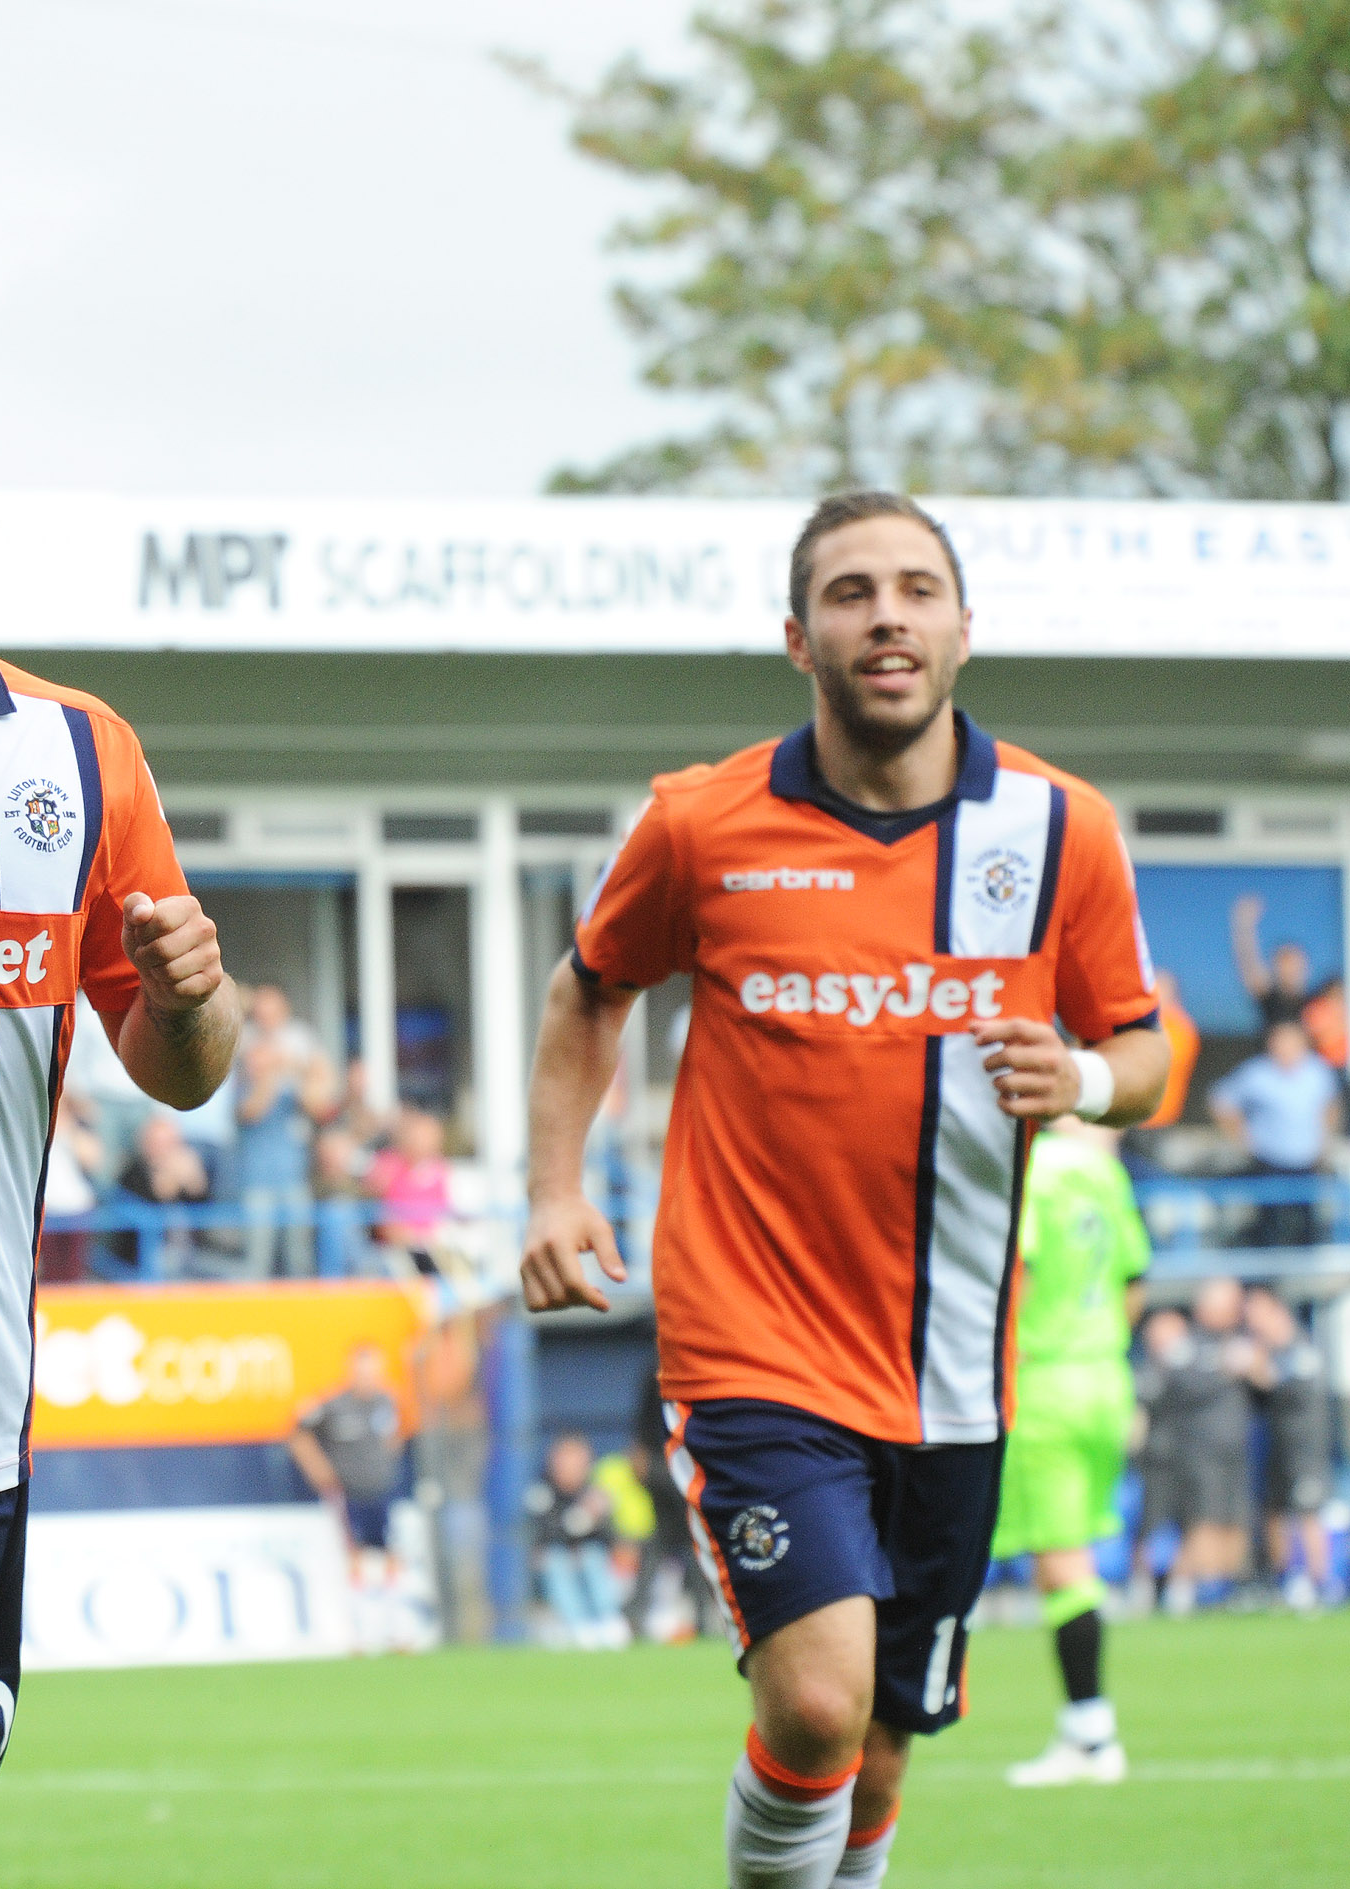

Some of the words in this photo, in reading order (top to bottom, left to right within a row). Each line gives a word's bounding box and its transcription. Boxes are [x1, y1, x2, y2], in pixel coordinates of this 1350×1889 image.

[318, 532, 735, 612] SCAFFOLDING
[7, 779, 37, 801] LUTON
[41, 779, 69, 801] TOWN
[4, 810, 21, 818] EST
[13, 827, 57, 853] FOOTBALL
[56, 828, 73, 849] CLUB
[740, 964, 1004, 1027] easyJet
